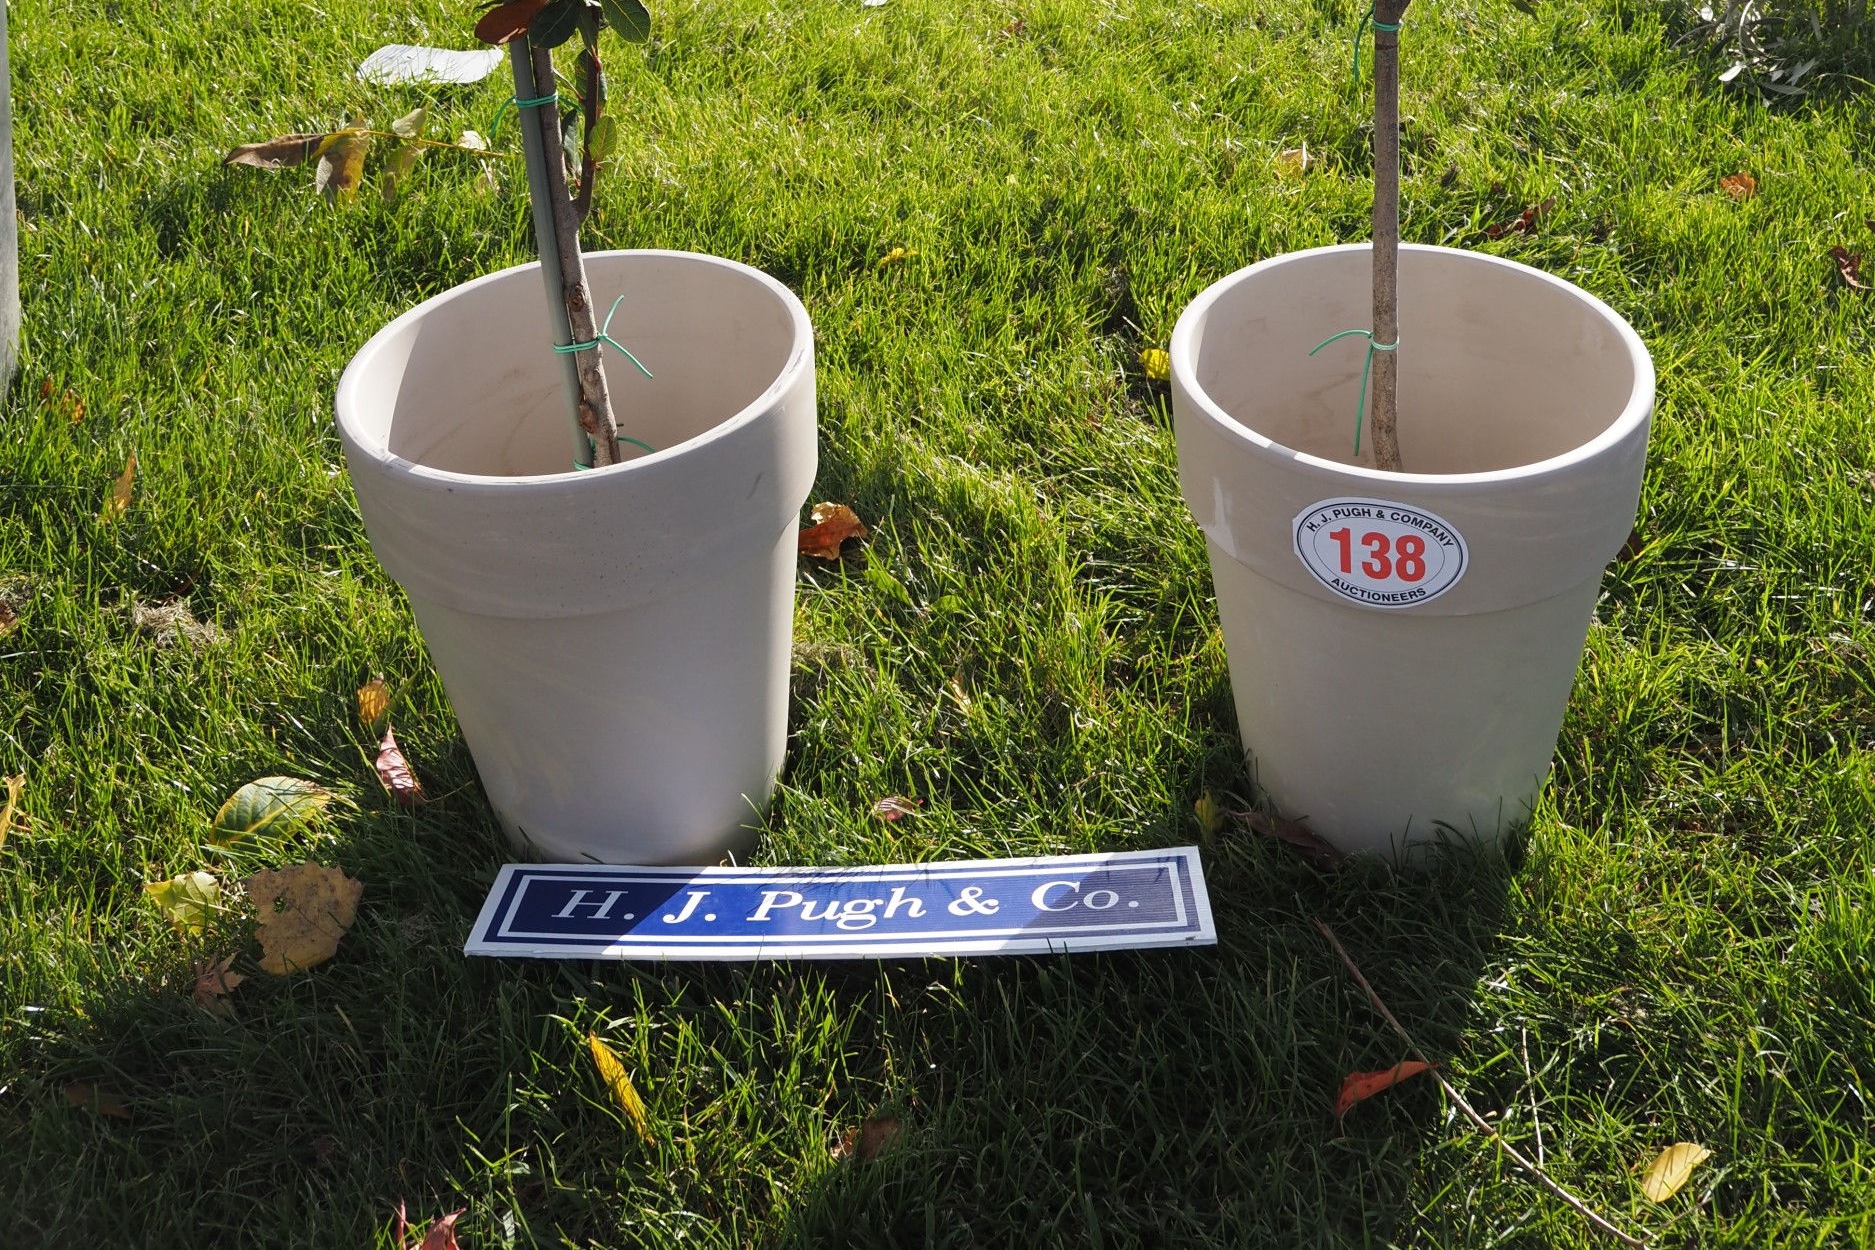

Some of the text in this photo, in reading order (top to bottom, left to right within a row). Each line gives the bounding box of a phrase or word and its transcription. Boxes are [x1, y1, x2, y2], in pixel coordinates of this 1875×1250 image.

[1306, 507, 1454, 548] H. J. PUGH & COMPANY
[1329, 527, 1426, 582] 138
[1331, 577, 1426, 602] AUCTIONEERS
[551, 880, 1140, 931] H. J. Pugh & Co.
